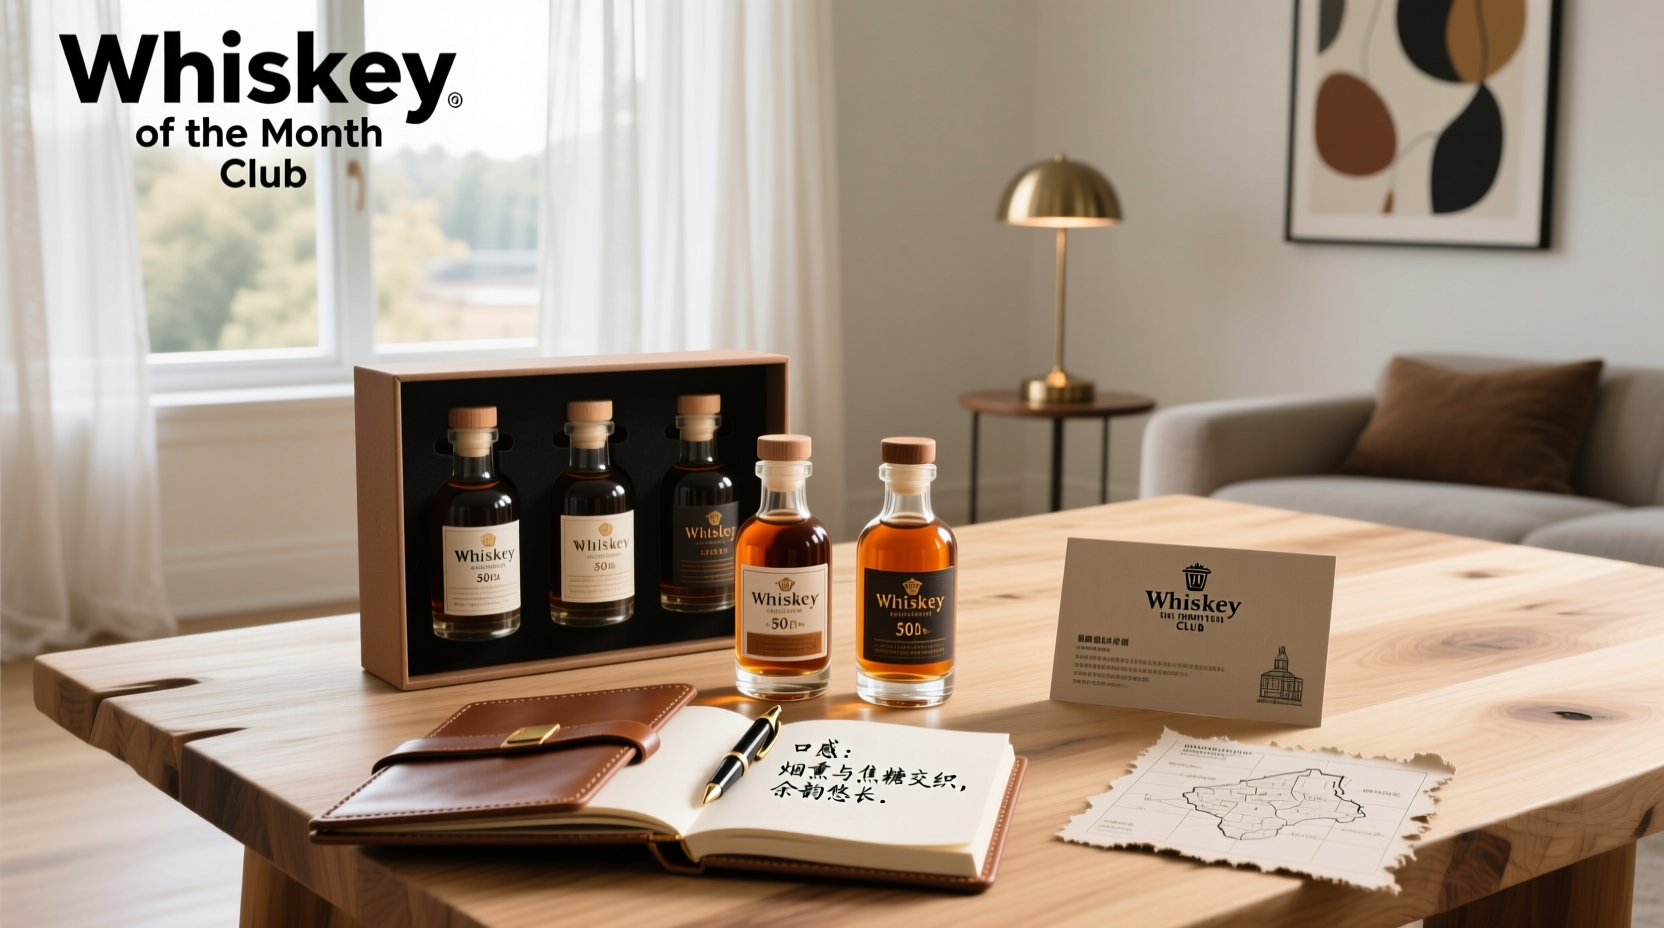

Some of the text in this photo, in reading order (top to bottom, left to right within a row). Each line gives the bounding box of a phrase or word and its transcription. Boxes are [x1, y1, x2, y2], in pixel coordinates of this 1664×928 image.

[454, 548, 515, 563] Whiskey
[751, 591, 819, 610] Whiskey
[876, 593, 945, 613] Whiskey
[1145, 590, 1242, 619] Whiskey
